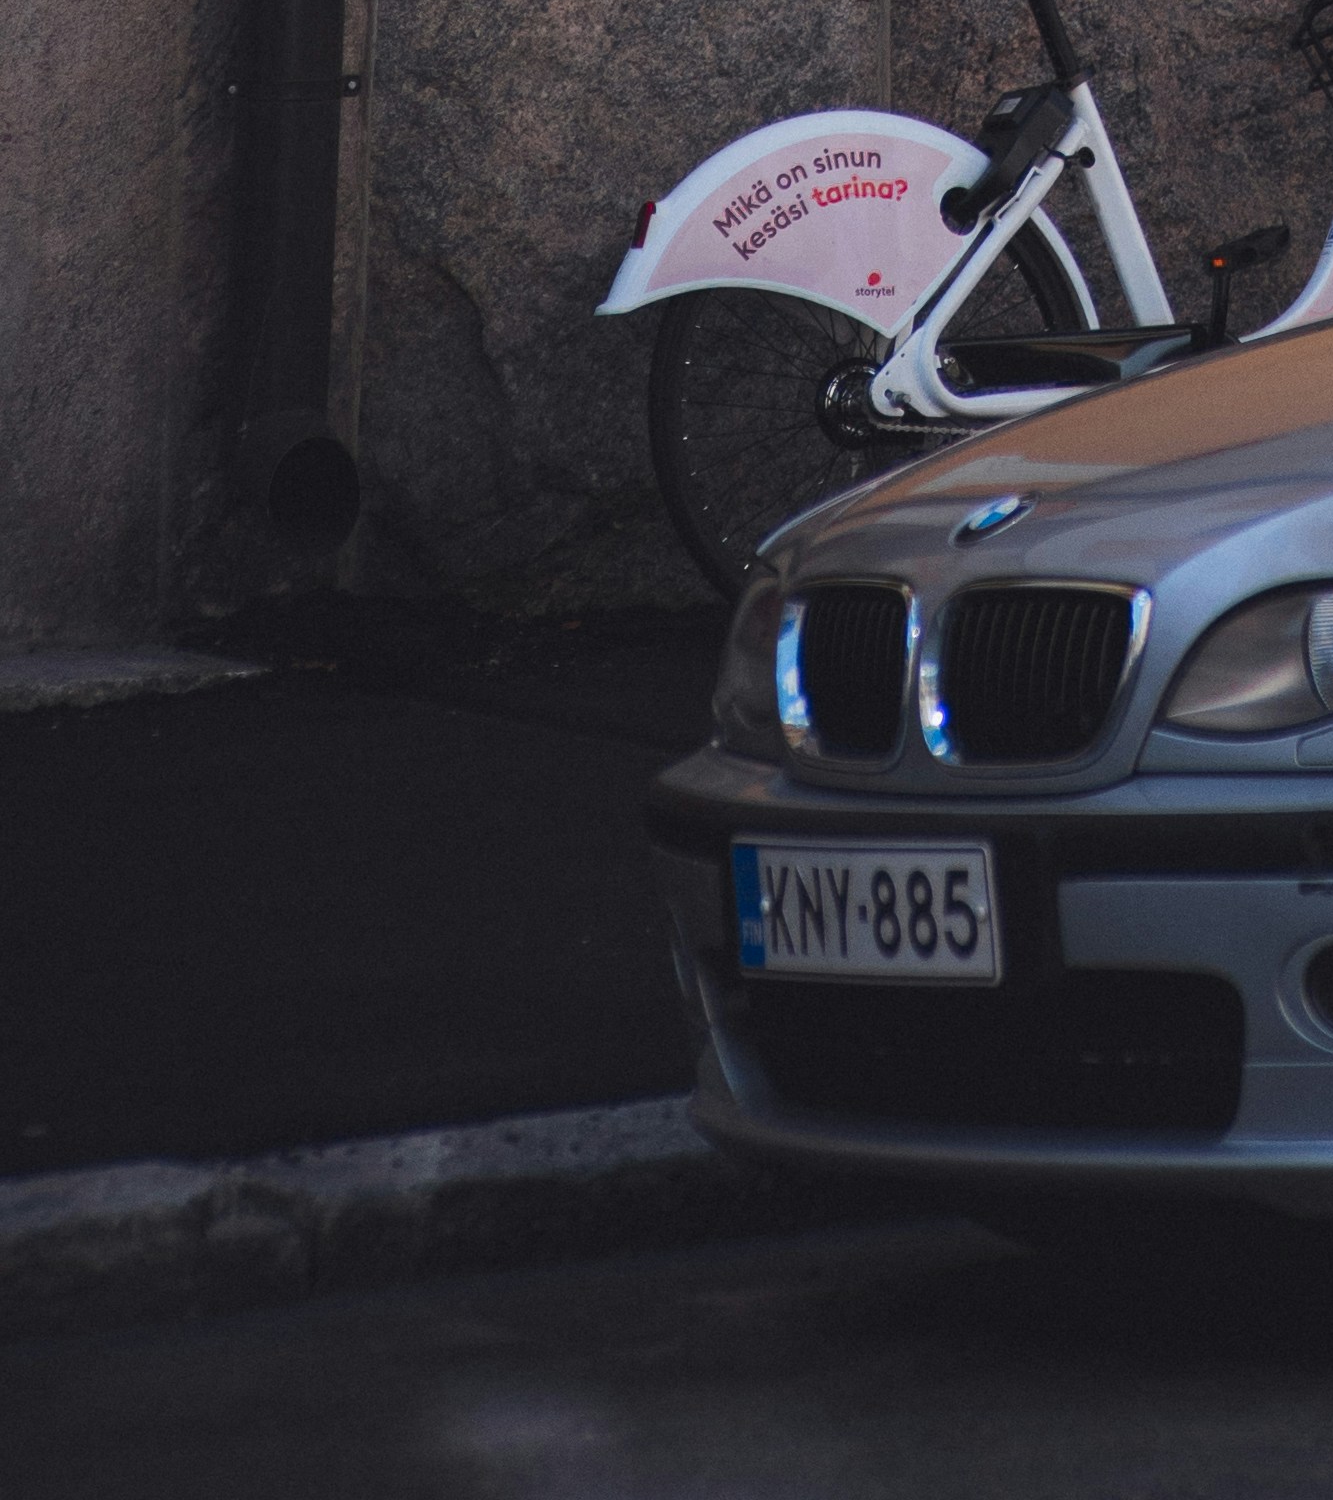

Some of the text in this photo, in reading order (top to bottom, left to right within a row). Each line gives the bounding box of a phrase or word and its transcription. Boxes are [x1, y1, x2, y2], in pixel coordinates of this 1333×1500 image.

[712, 148, 882, 238] Mikä on sinun
[732, 175, 909, 261] kesäsi tarina?
[854, 285, 895, 298] storytel
[765, 865, 979, 960] KNY-885
